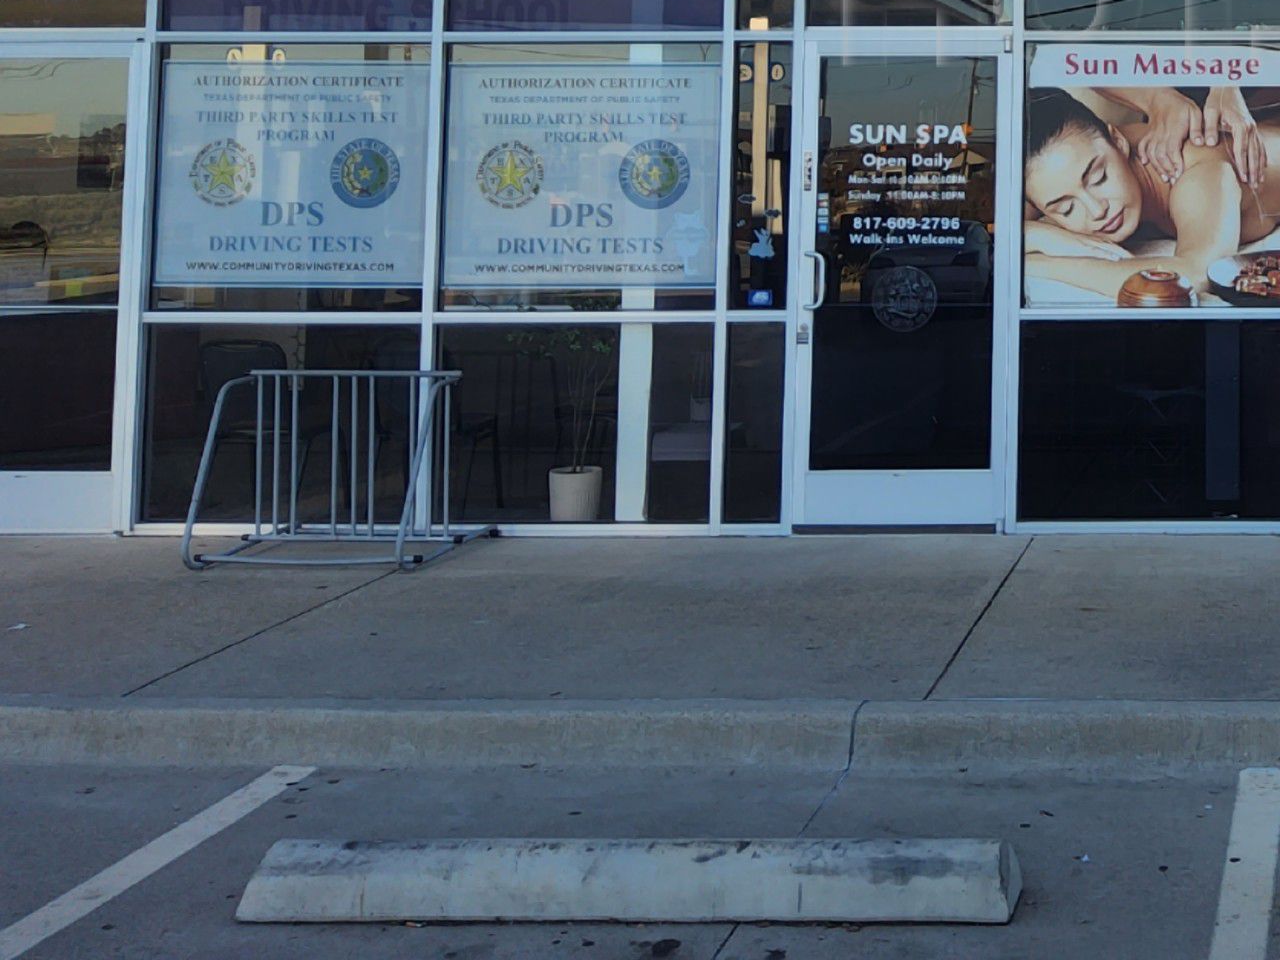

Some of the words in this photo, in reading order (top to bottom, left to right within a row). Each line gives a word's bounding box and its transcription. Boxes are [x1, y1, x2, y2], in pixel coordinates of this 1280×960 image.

[1065, 52, 1119, 76] Sun
[1133, 52, 1261, 81] Massage
[194, 76, 308, 88] AUTHORIZATION
[312, 76, 404, 88] CERTIFICATE
[478, 77, 599, 89] AUTHORIZATION
[600, 77, 692, 89] CERTIFICATE
[197, 111, 244, 123] THIRD
[249, 111, 296, 123] PARTY
[302, 111, 356, 123] SKILLS
[362, 111, 399, 123] TEST
[482, 112, 531, 125] THIRD
[537, 112, 584, 125] PARTY
[591, 112, 645, 125] SKILLS
[650, 112, 688, 125] TEST
[256, 129, 335, 141] PROGRAM
[544, 130, 623, 142] PROGRAM
[850, 124, 907, 144] SUN
[916, 124, 968, 144] SPA
[862, 153, 907, 170] Open
[912, 152, 953, 170] Daily
[260, 201, 324, 227] DPS
[550, 202, 614, 228] DPS
[852, 216, 960, 230] 817-609-2796
[209, 235, 302, 253] DRIVING
[308, 235, 373, 253] TESTS
[497, 237, 591, 254] DRIVING
[600, 237, 664, 254] TESTS
[907, 233, 965, 245] Welcome
[474, 262, 685, 273] WWW.COMMUNITYDRIVINGTEXAS.COM
